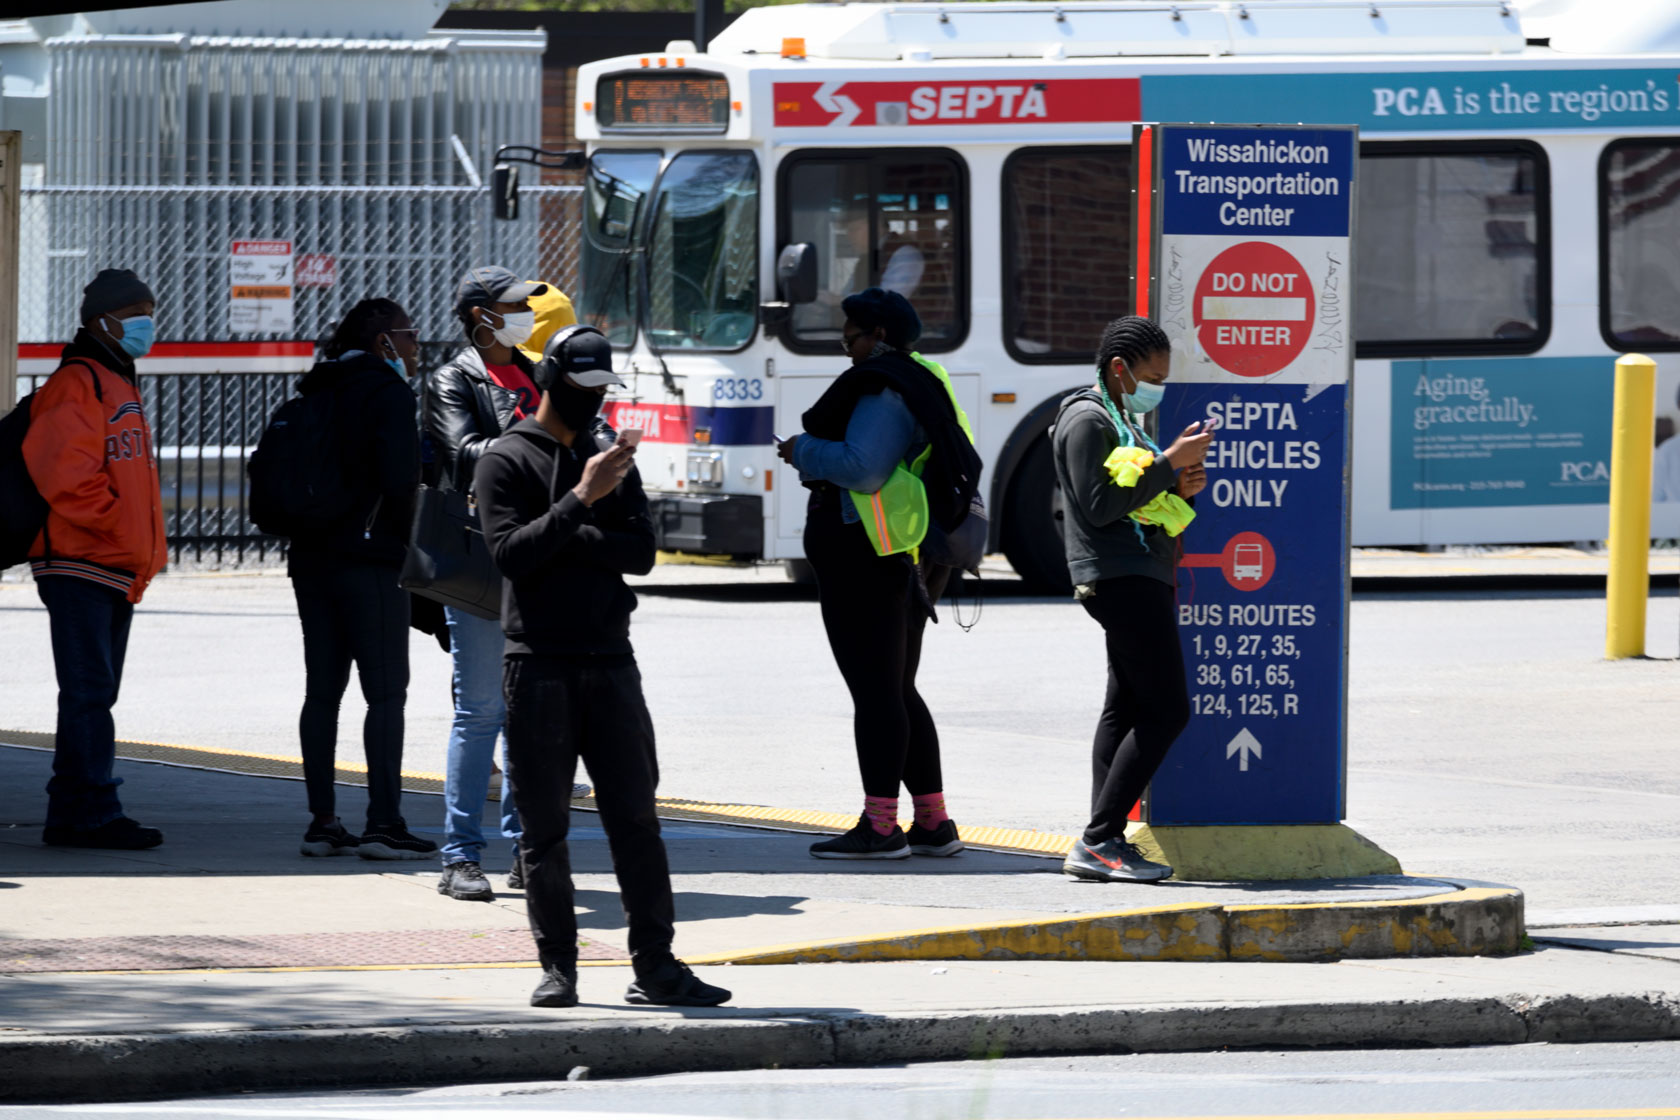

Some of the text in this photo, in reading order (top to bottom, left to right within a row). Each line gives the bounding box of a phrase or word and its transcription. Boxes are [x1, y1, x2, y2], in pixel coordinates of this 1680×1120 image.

[909, 86, 1047, 120] SEPTA
[1372, 88, 1448, 116] PCA
[1454, 86, 1480, 115] is
[1488, 83, 1540, 114] the
[1548, 80, 1669, 121] region's
[1186, 139, 1329, 164] Wissahickon
[1175, 170, 1339, 200] Transportation
[1219, 202, 1295, 226] Center
[1212, 273, 1298, 293] DO NOT
[1216, 326, 1291, 346] ENTER
[714, 378, 763, 400] 8333
[1413, 374, 1490, 402] Aging,
[616, 408, 661, 438] SEPTA
[1205, 402, 1298, 430] SEPTA
[1414, 397, 1538, 431] gracefully.
[104, 428, 154, 461] AST
[1202, 441, 1320, 470] EHICLES
[1560, 461, 1610, 482] PCA
[1212, 479, 1288, 507] ONLY
[1178, 604, 1316, 627] BUS ROUTES
[1192, 635, 1301, 657] 1, 9, 27, 35,
[1196, 664, 1295, 687] 38, 61, 65,
[1192, 694, 1299, 718] 124, 125, R
